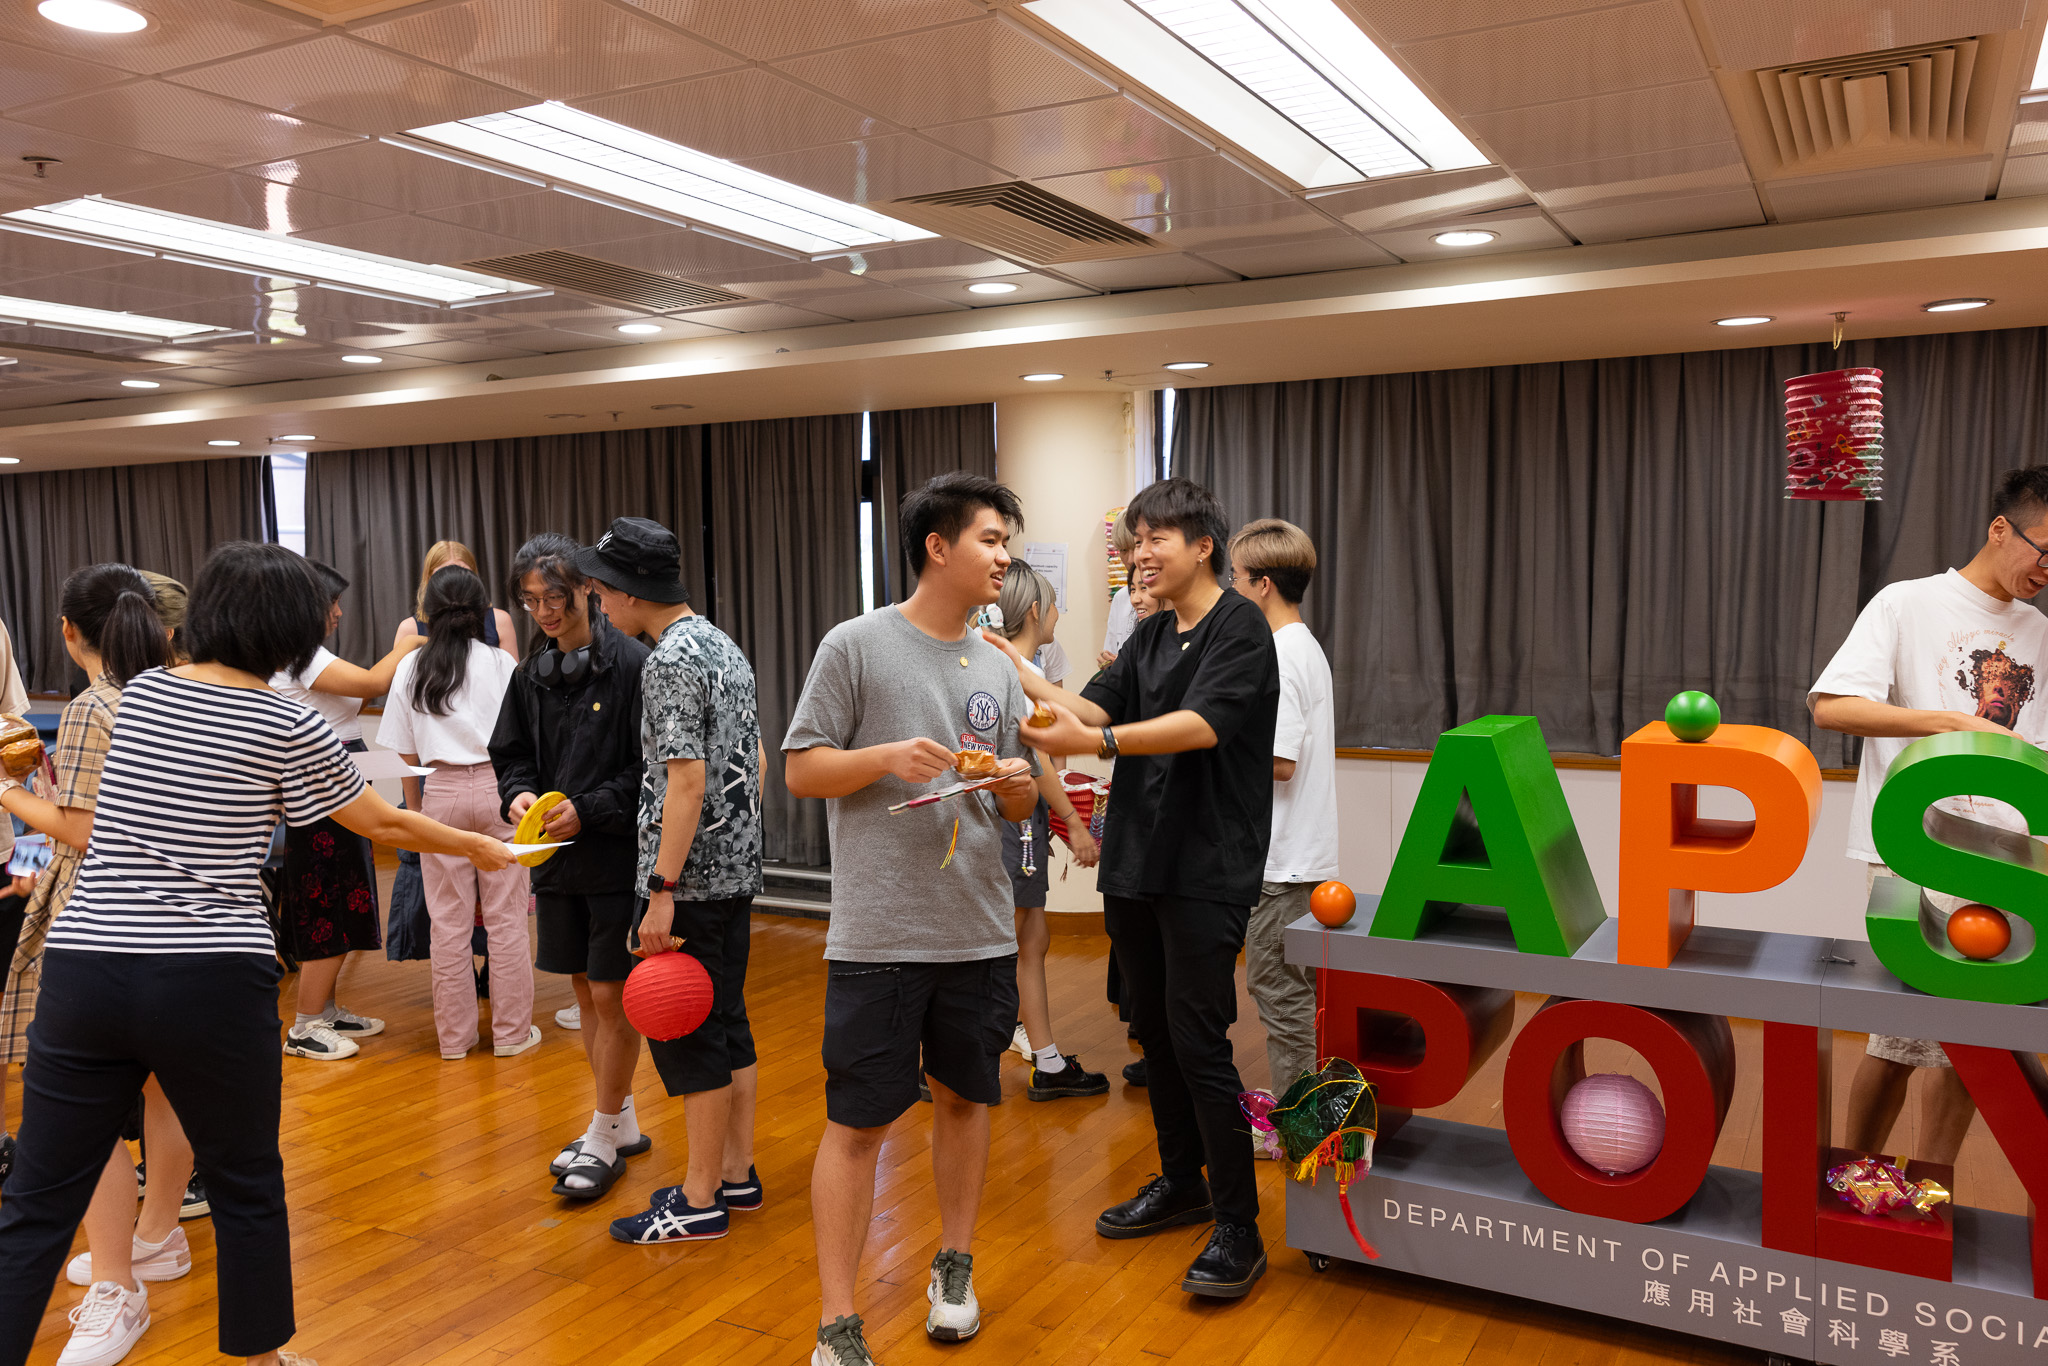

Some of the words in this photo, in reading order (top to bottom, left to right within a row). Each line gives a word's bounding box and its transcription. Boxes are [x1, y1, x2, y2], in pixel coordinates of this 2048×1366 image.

[963, 741, 977, 751] NEW
[977, 743, 994, 754] YORK
[573, 1154, 598, 1164] NIKE
[1383, 1198, 1622, 1262] DEPARTMENT
[1641, 1248, 1690, 1276] OF
[1709, 1261, 1889, 1317] APPLIED
[1642, 1279, 1961, 1366] 應用社會科學系
